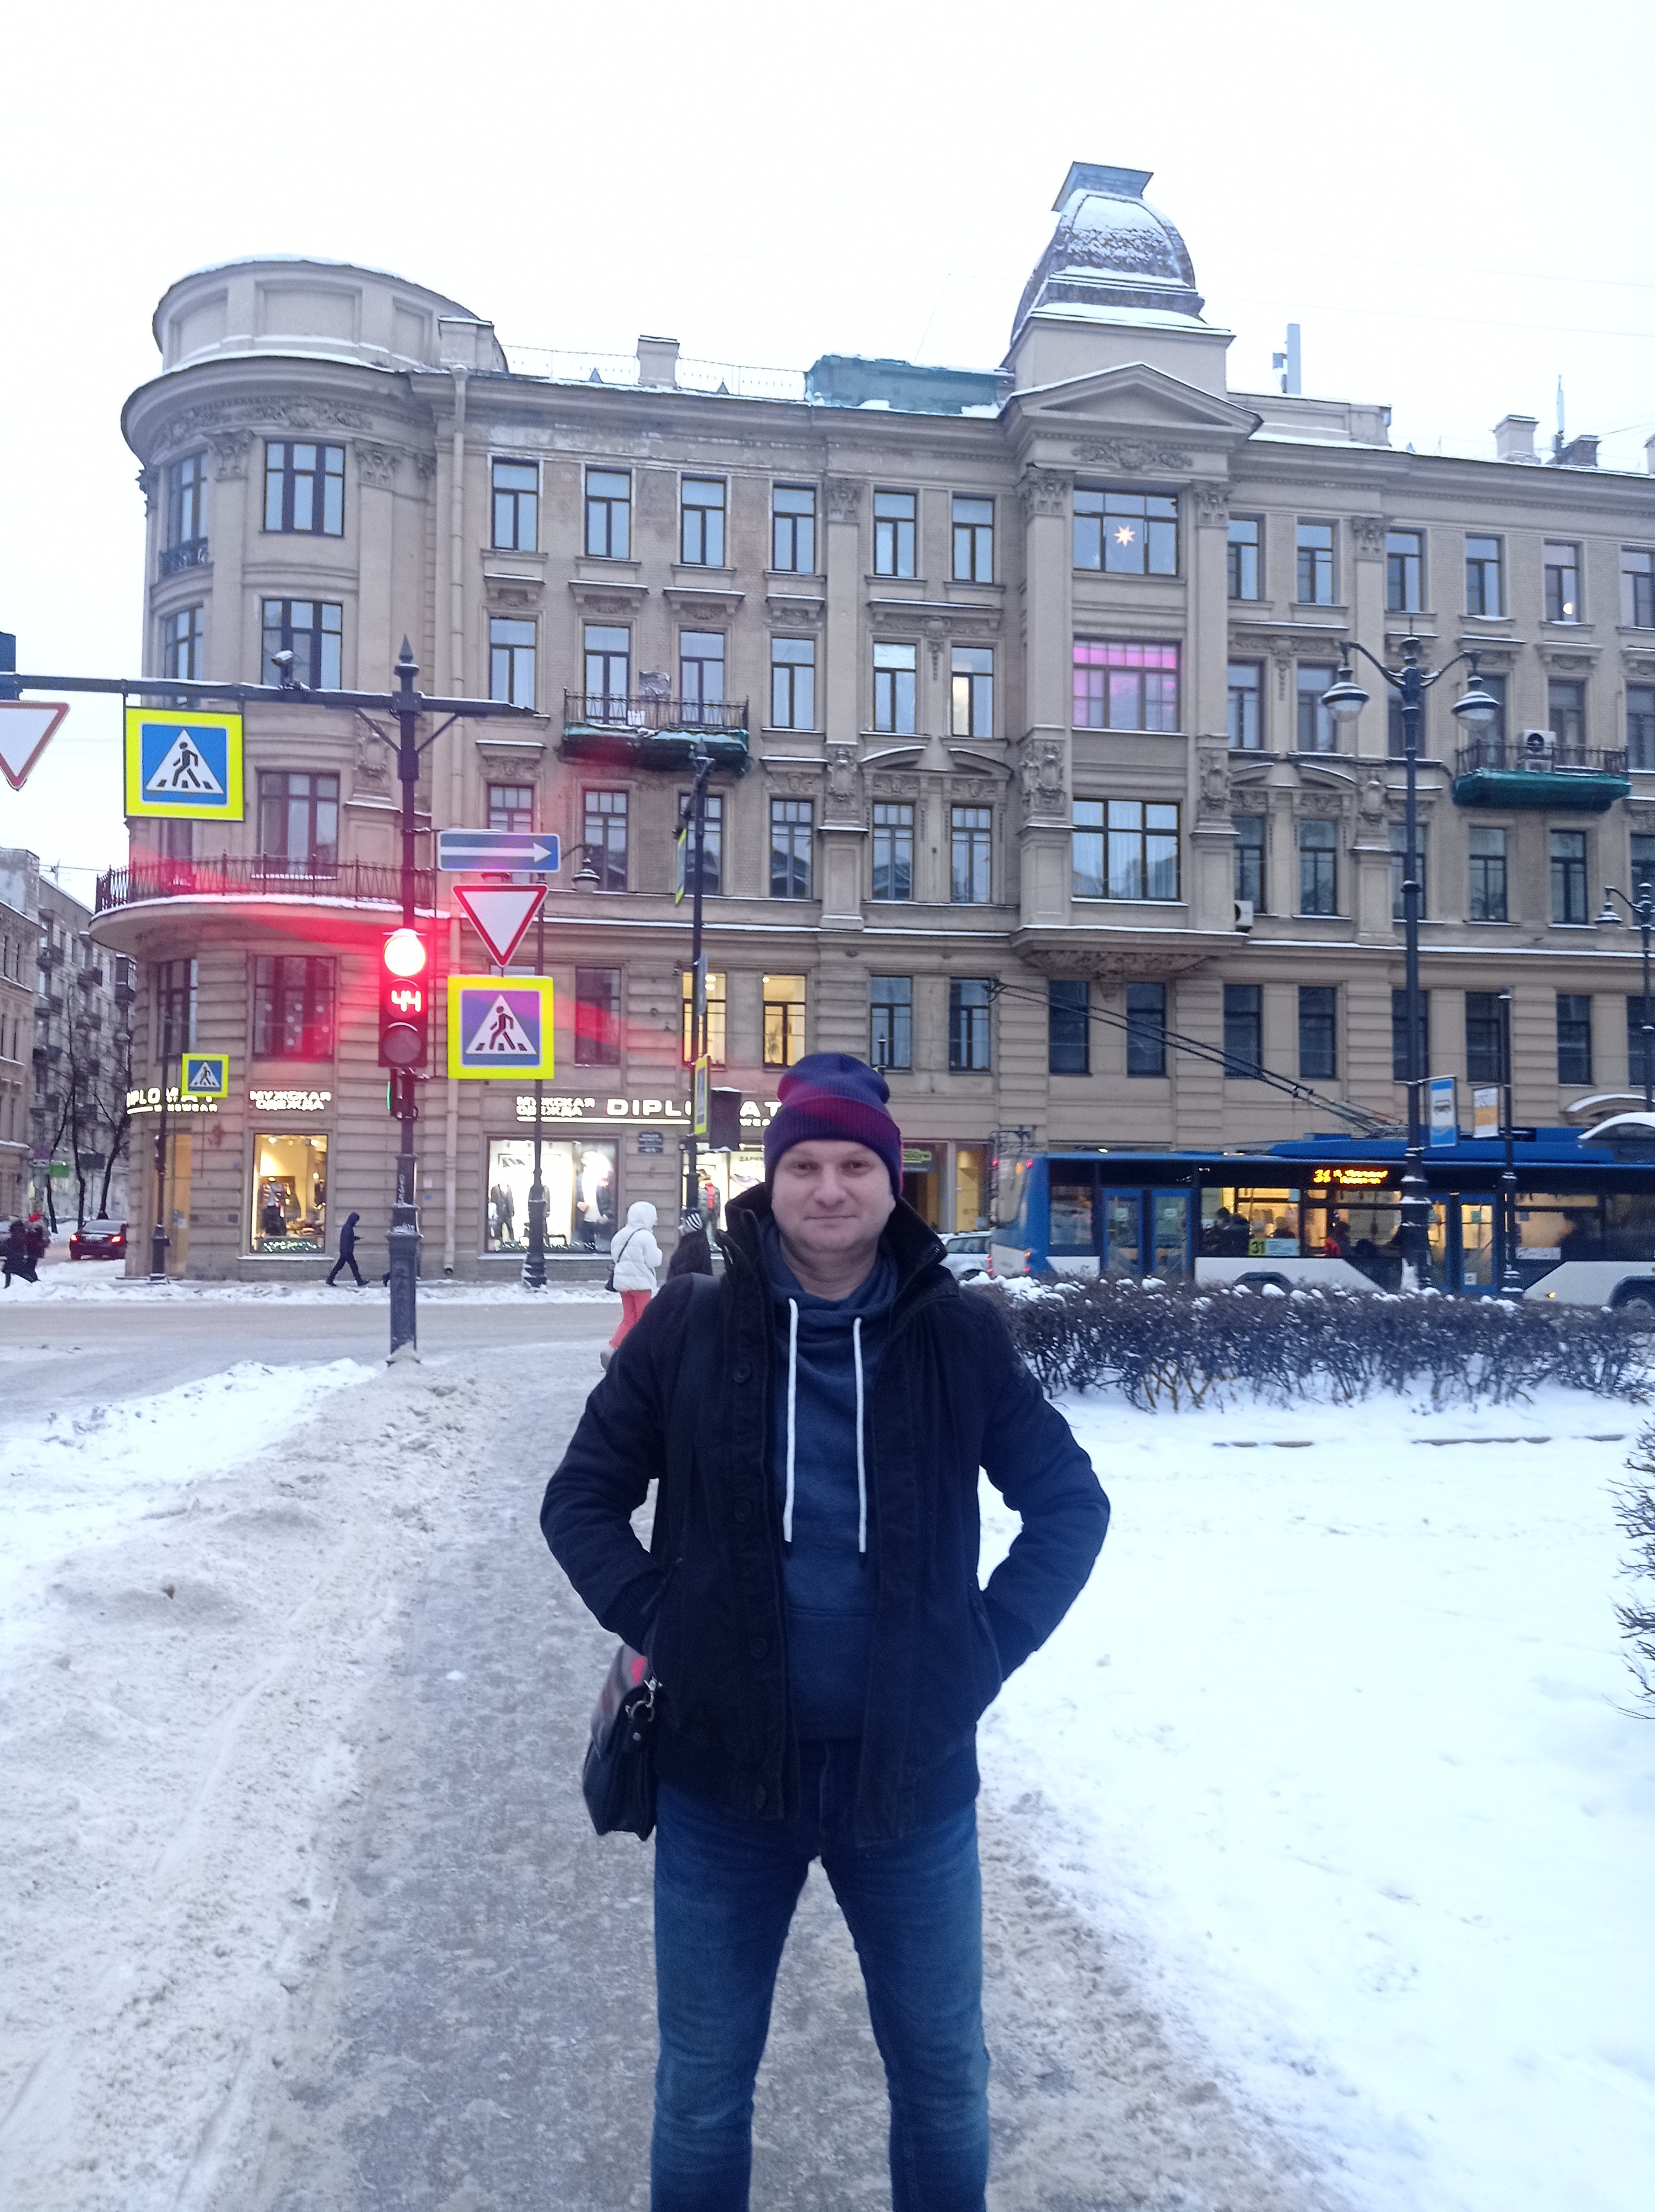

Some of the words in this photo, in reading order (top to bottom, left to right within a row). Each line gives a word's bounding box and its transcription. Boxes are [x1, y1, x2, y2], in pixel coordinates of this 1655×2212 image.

[391, 990, 421, 1013] 44
[249, 1091, 331, 1101] МУЖСКАЯ
[256, 1099, 325, 1111] ОДЕЖДА
[1313, 1169, 1331, 1183] 31
[1252, 1241, 1264, 1254] 31
